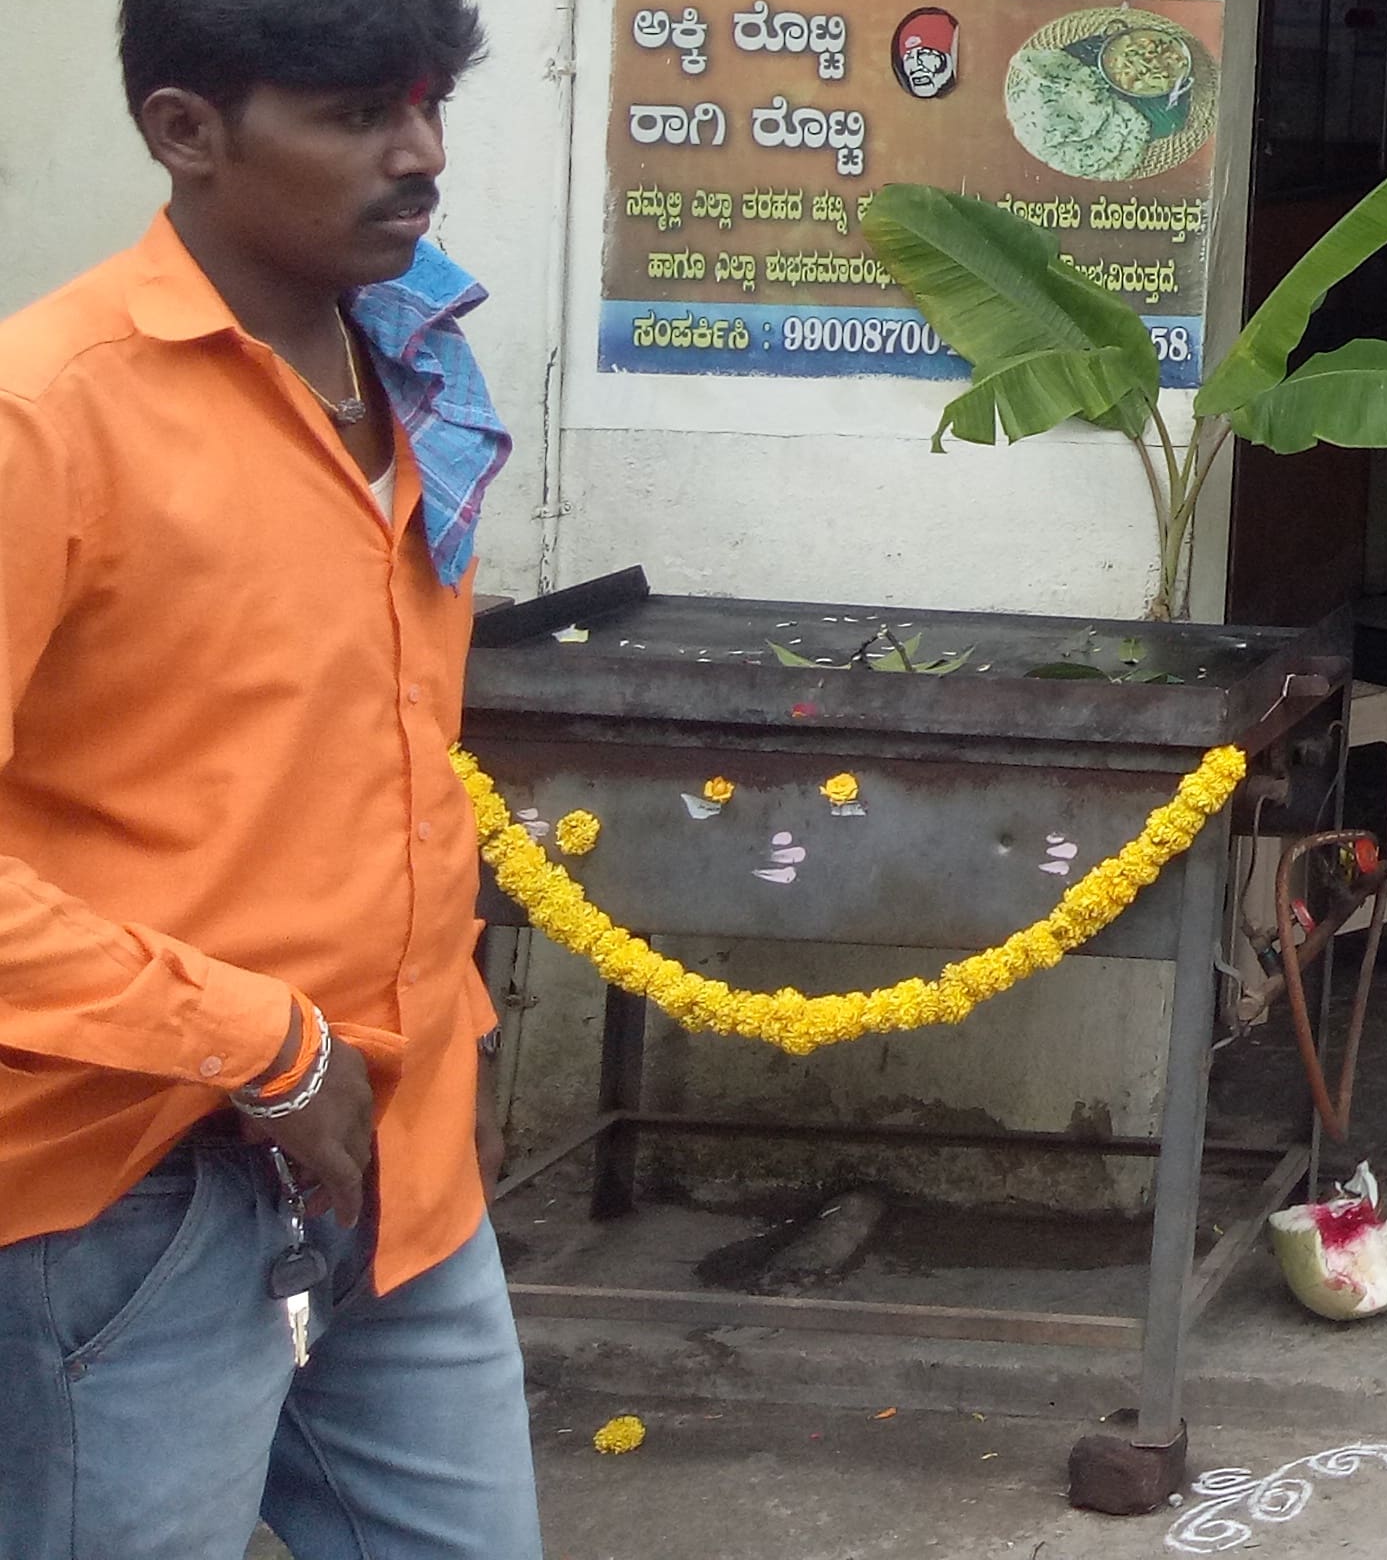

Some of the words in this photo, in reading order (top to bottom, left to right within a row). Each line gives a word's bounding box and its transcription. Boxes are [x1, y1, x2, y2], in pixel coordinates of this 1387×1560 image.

[632, 6, 708, 75] ಅಕ್ಕಿ
[732, 0, 847, 80] ರೊಟ್ಟಿ
[629, 101, 727, 146] ರಾಗಿ
[751, 96, 866, 176] ರೊಟ್ಟಿ
[691, 189, 733, 228] ಎಲ್ಲಾ
[742, 187, 803, 221] ತರಹದ
[812, 188, 849, 235] ಚಟ್ನಿ
[648, 248, 706, 280] ಹಾಗೂ
[715, 250, 757, 291] ಎಲ್ಲಾ
[632, 311, 750, 349] ಸಂಪರ್ಕಿಸಿ
